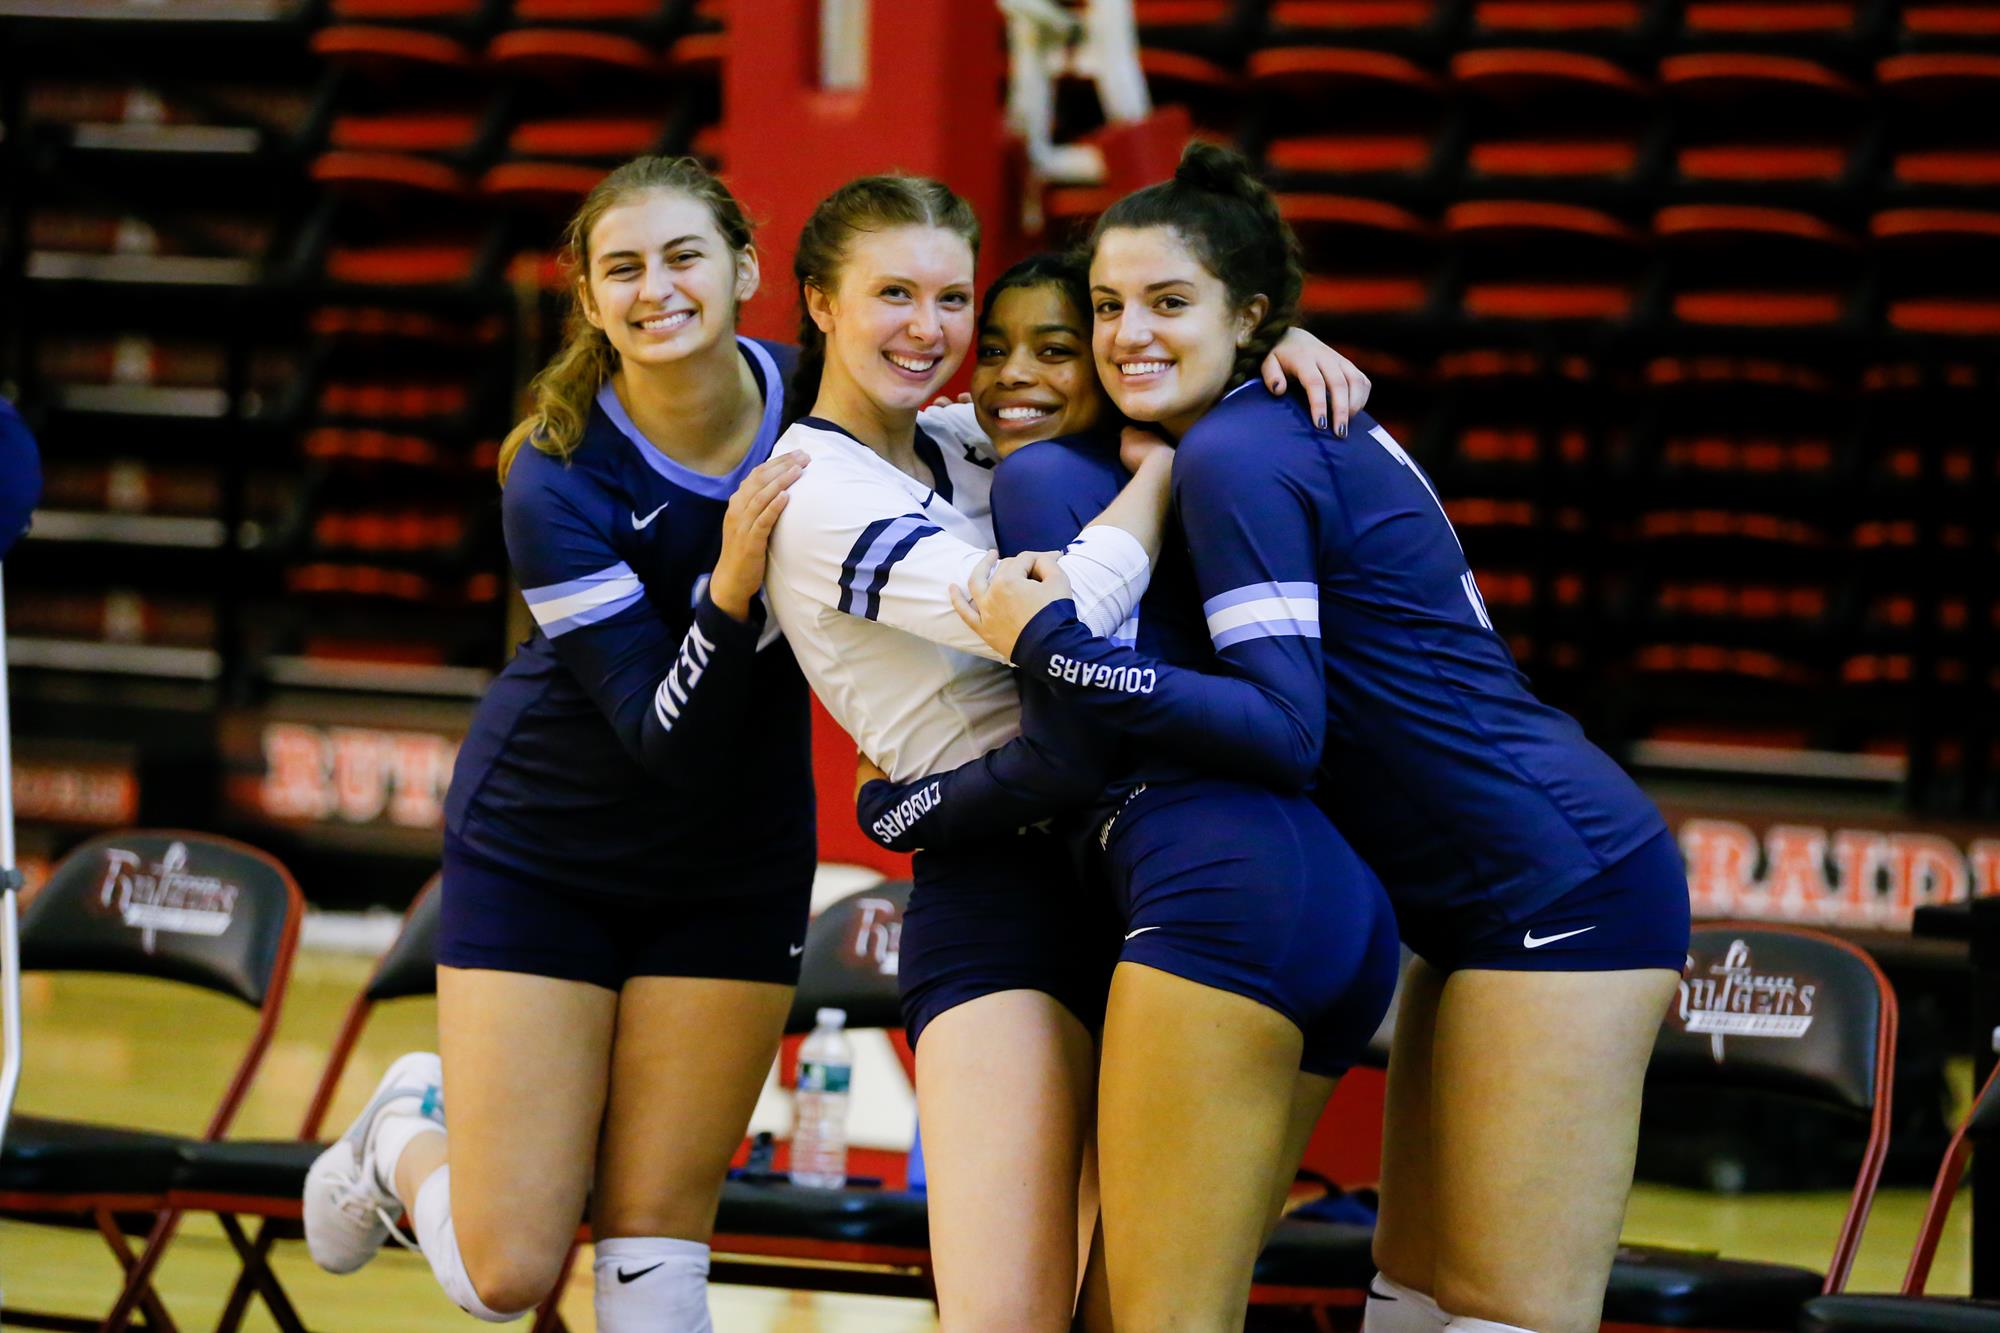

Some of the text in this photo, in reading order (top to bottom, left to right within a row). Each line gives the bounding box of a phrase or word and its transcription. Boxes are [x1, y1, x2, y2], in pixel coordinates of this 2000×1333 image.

[655, 619, 717, 733] KEAN
[1047, 653, 1157, 694] COUGARS
[262, 722, 462, 828] RUT
[872, 781, 942, 844] COUGARS
